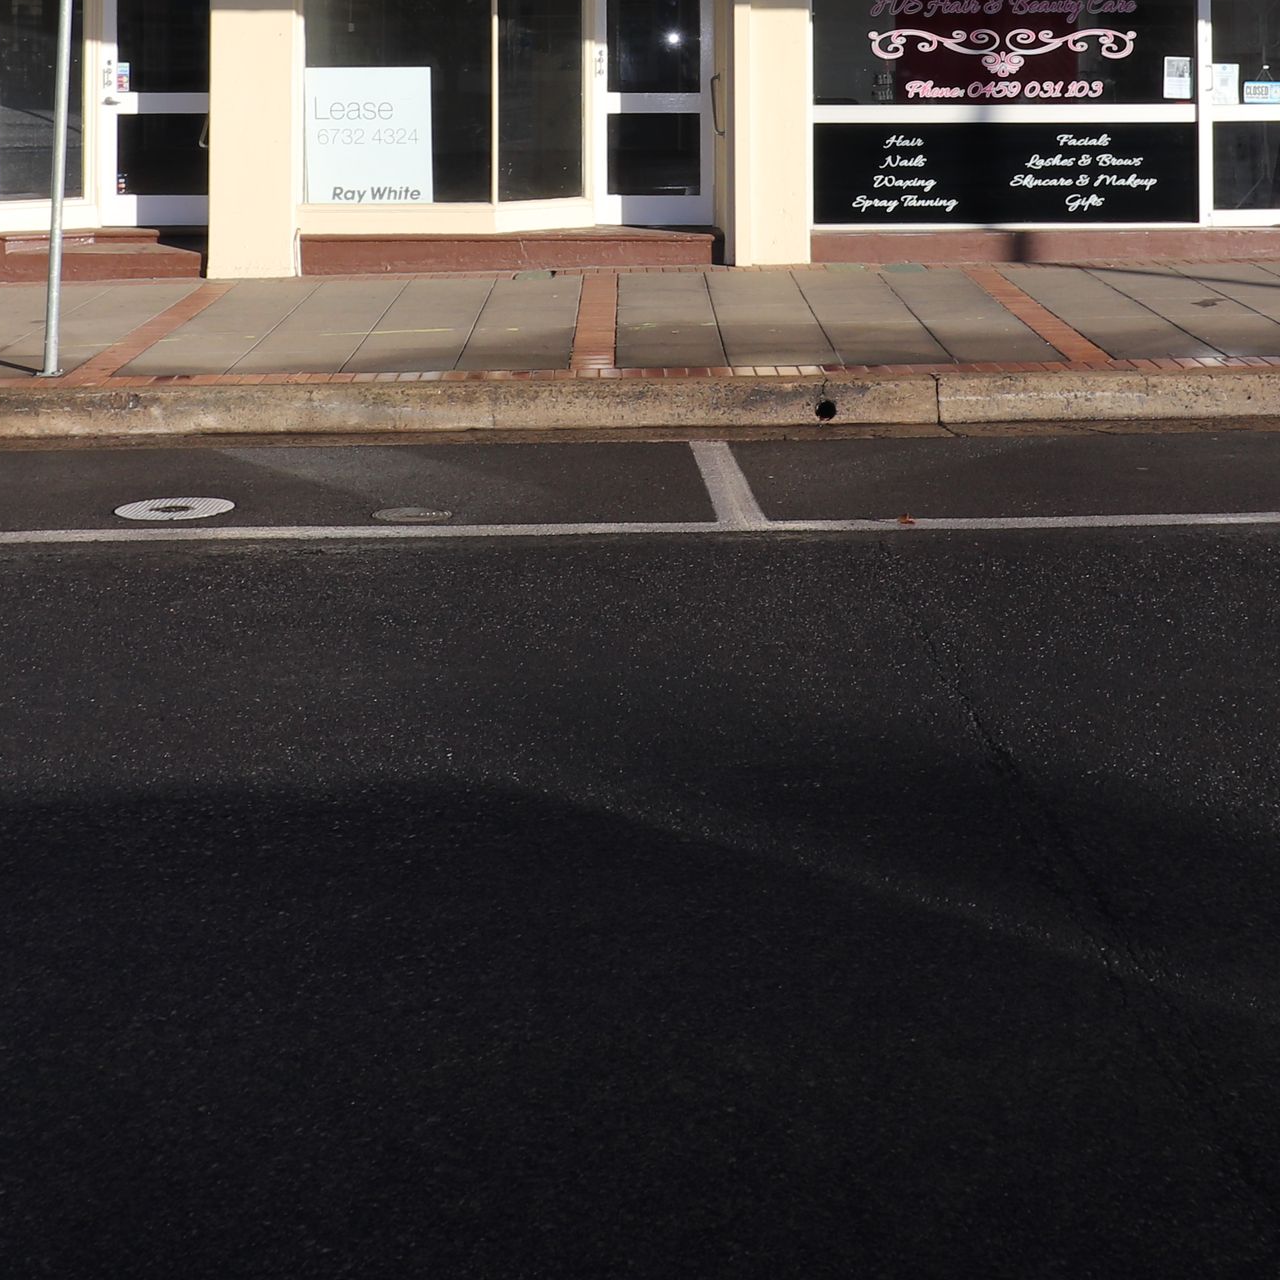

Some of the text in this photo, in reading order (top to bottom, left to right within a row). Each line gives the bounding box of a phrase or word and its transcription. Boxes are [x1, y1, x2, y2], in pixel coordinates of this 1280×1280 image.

[905, 80, 1104, 98] Phone: 0459 031 103
[314, 96, 394, 120] Lease
[317, 127, 419, 145] 6732 4324
[883, 134, 924, 149] Hair
[1056, 133, 1111, 146] Facials
[878, 154, 927, 169] Nails
[1024, 153, 1144, 169] Lashes & Brows
[873, 174, 937, 193] Waxing
[1009, 173, 1158, 191] Skincare & Makeup
[331, 186, 421, 203] Ray White
[1065, 194, 1106, 211] Gifts
[852, 194, 959, 213] Spray Tanning
